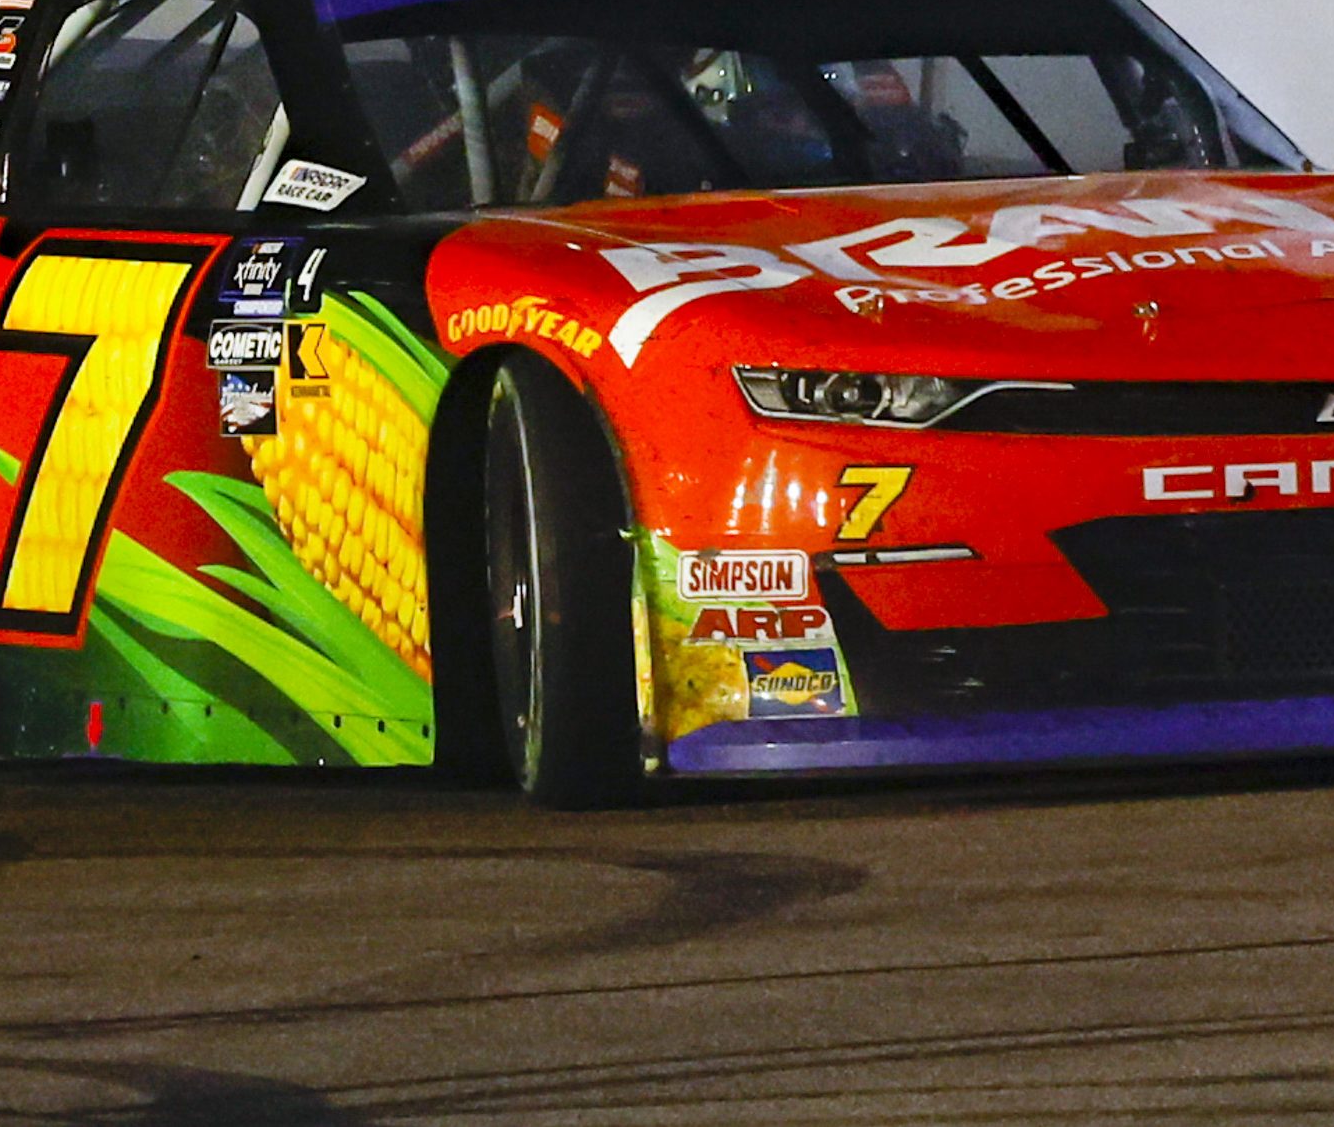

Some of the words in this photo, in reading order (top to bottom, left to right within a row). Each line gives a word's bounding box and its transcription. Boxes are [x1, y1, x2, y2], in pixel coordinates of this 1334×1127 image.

[277, 183, 306, 197] RACE
[305, 188, 334, 203] CAR
[233, 254, 283, 289] xfinity
[297, 248, 328, 302] 4
[833, 239, 1285, 314] Professional
[209, 328, 283, 359] COMETIC
[447, 295, 603, 359] GOODYEAR
[834, 464, 914, 541] 7
[687, 559, 794, 592] SIMPSON
[687, 607, 827, 640] ARP
[753, 674, 835, 693] SUNOCO
